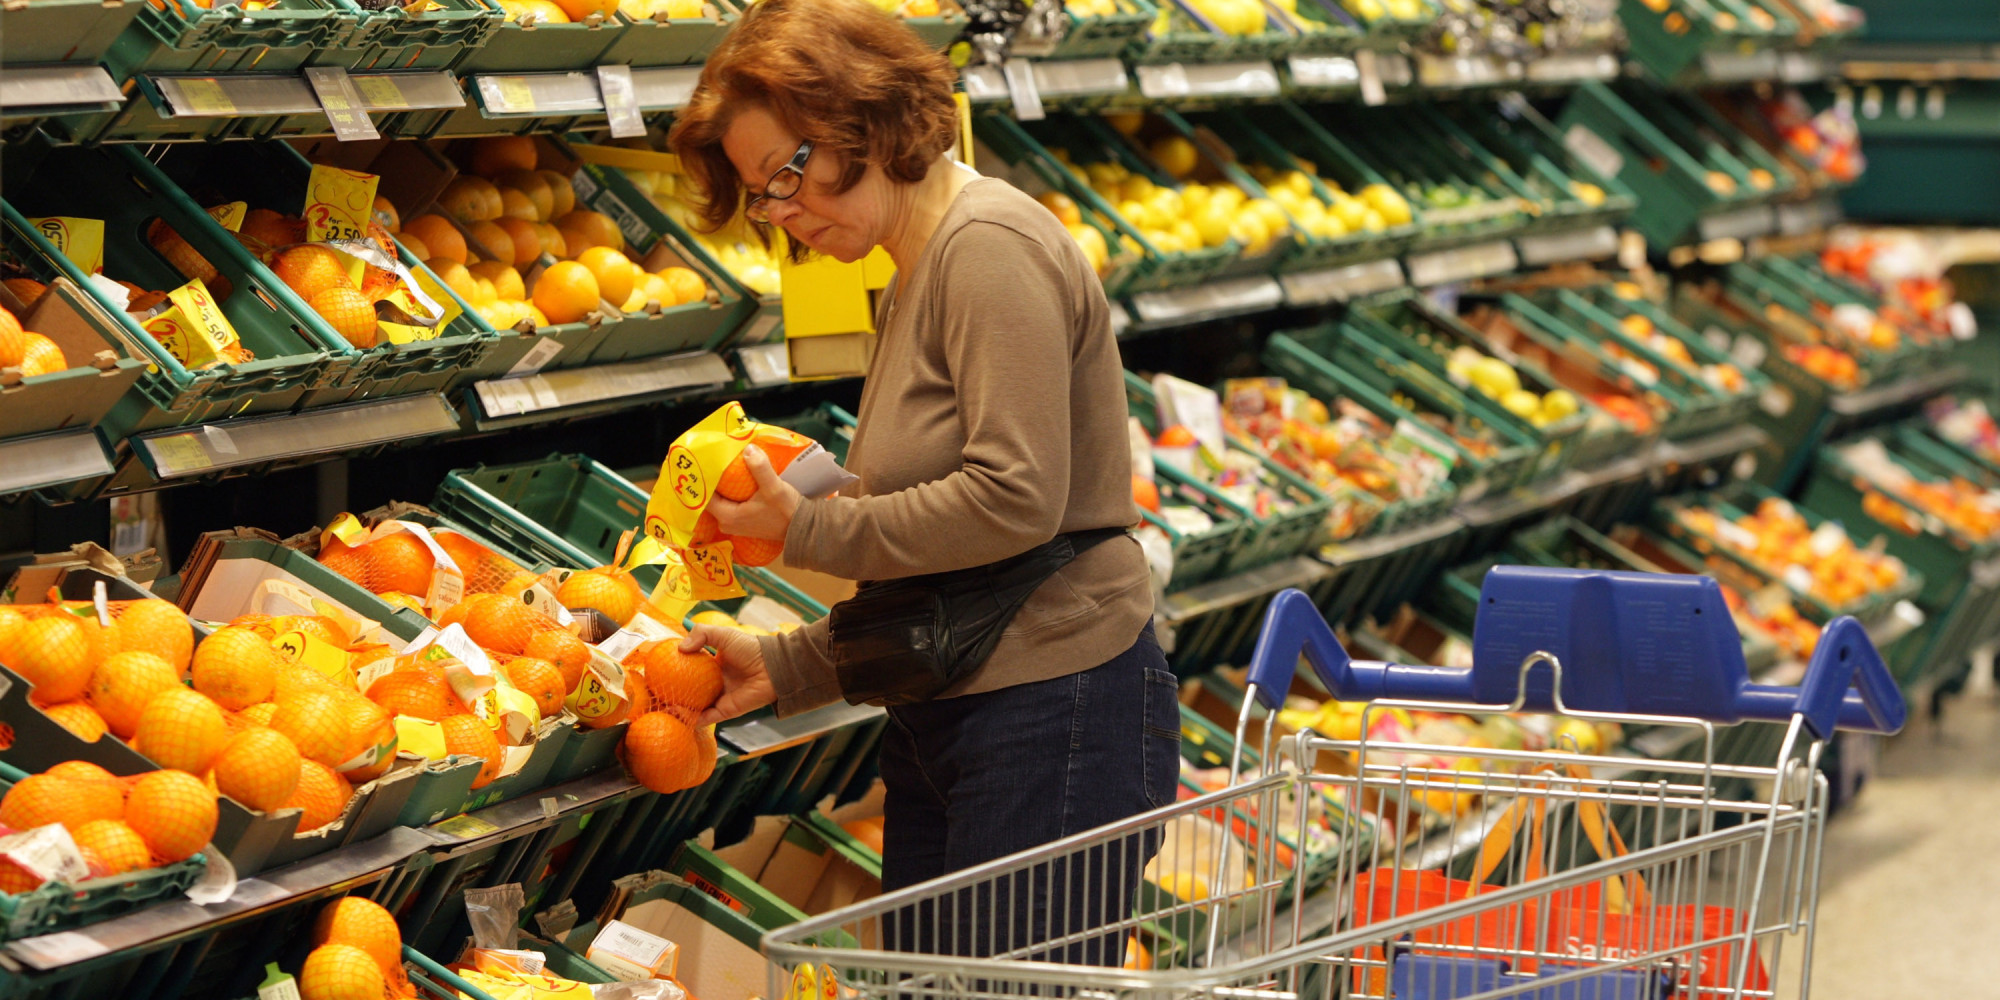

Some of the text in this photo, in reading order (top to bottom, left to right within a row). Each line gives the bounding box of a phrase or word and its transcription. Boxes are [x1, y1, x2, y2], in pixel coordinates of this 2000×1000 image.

[315, 207, 329, 229] 2
[326, 226, 360, 240] £250
[150, 324, 178, 347] 2 for
[676, 454, 698, 483] for £3
[675, 474, 699, 499] Any 3
[693, 549, 708, 561] £3
[704, 562, 717, 582] 3
[281, 641, 297, 656] 3
[589, 679, 602, 694] £3
[577, 697, 599, 711] 3
[694, 876, 732, 907] VALENCIA
